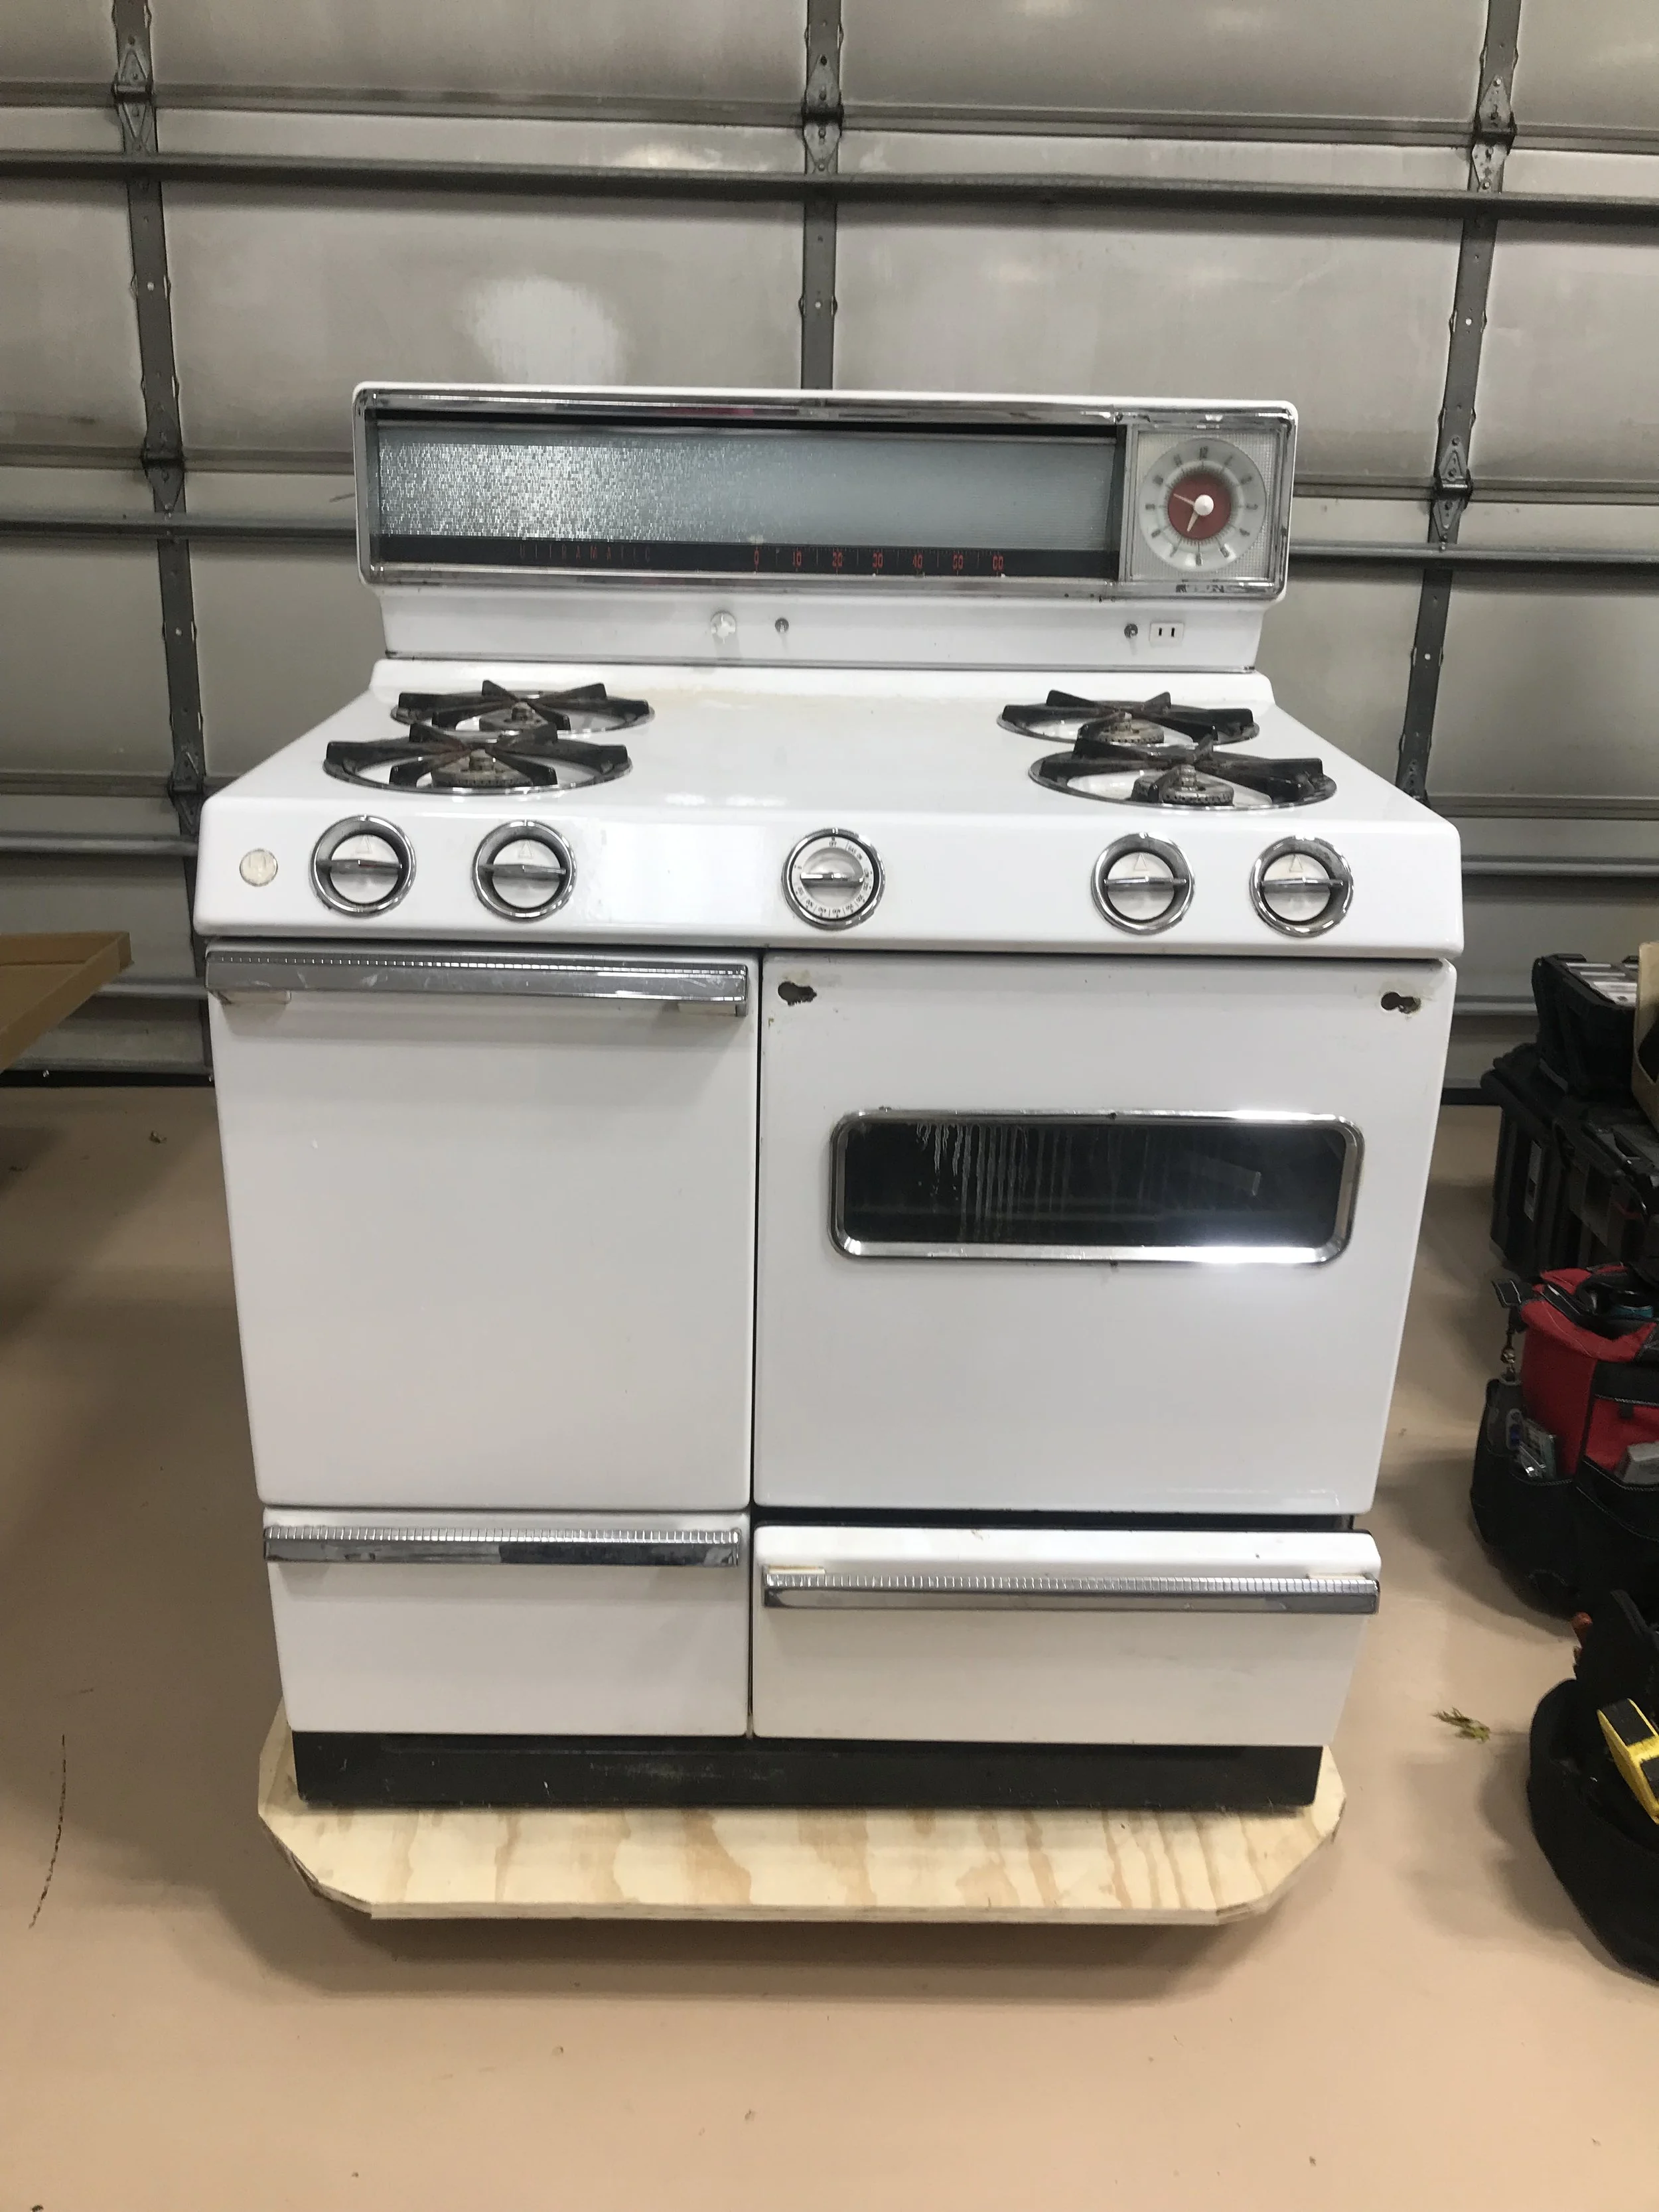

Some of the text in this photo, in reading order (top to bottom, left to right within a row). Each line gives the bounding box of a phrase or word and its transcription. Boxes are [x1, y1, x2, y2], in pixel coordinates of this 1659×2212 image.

[754, 550, 760, 565] 0
[792, 550, 802, 567] 10
[832, 551, 843, 567] 20
[872, 552, 883, 568] 30
[912, 553, 923, 569] 40
